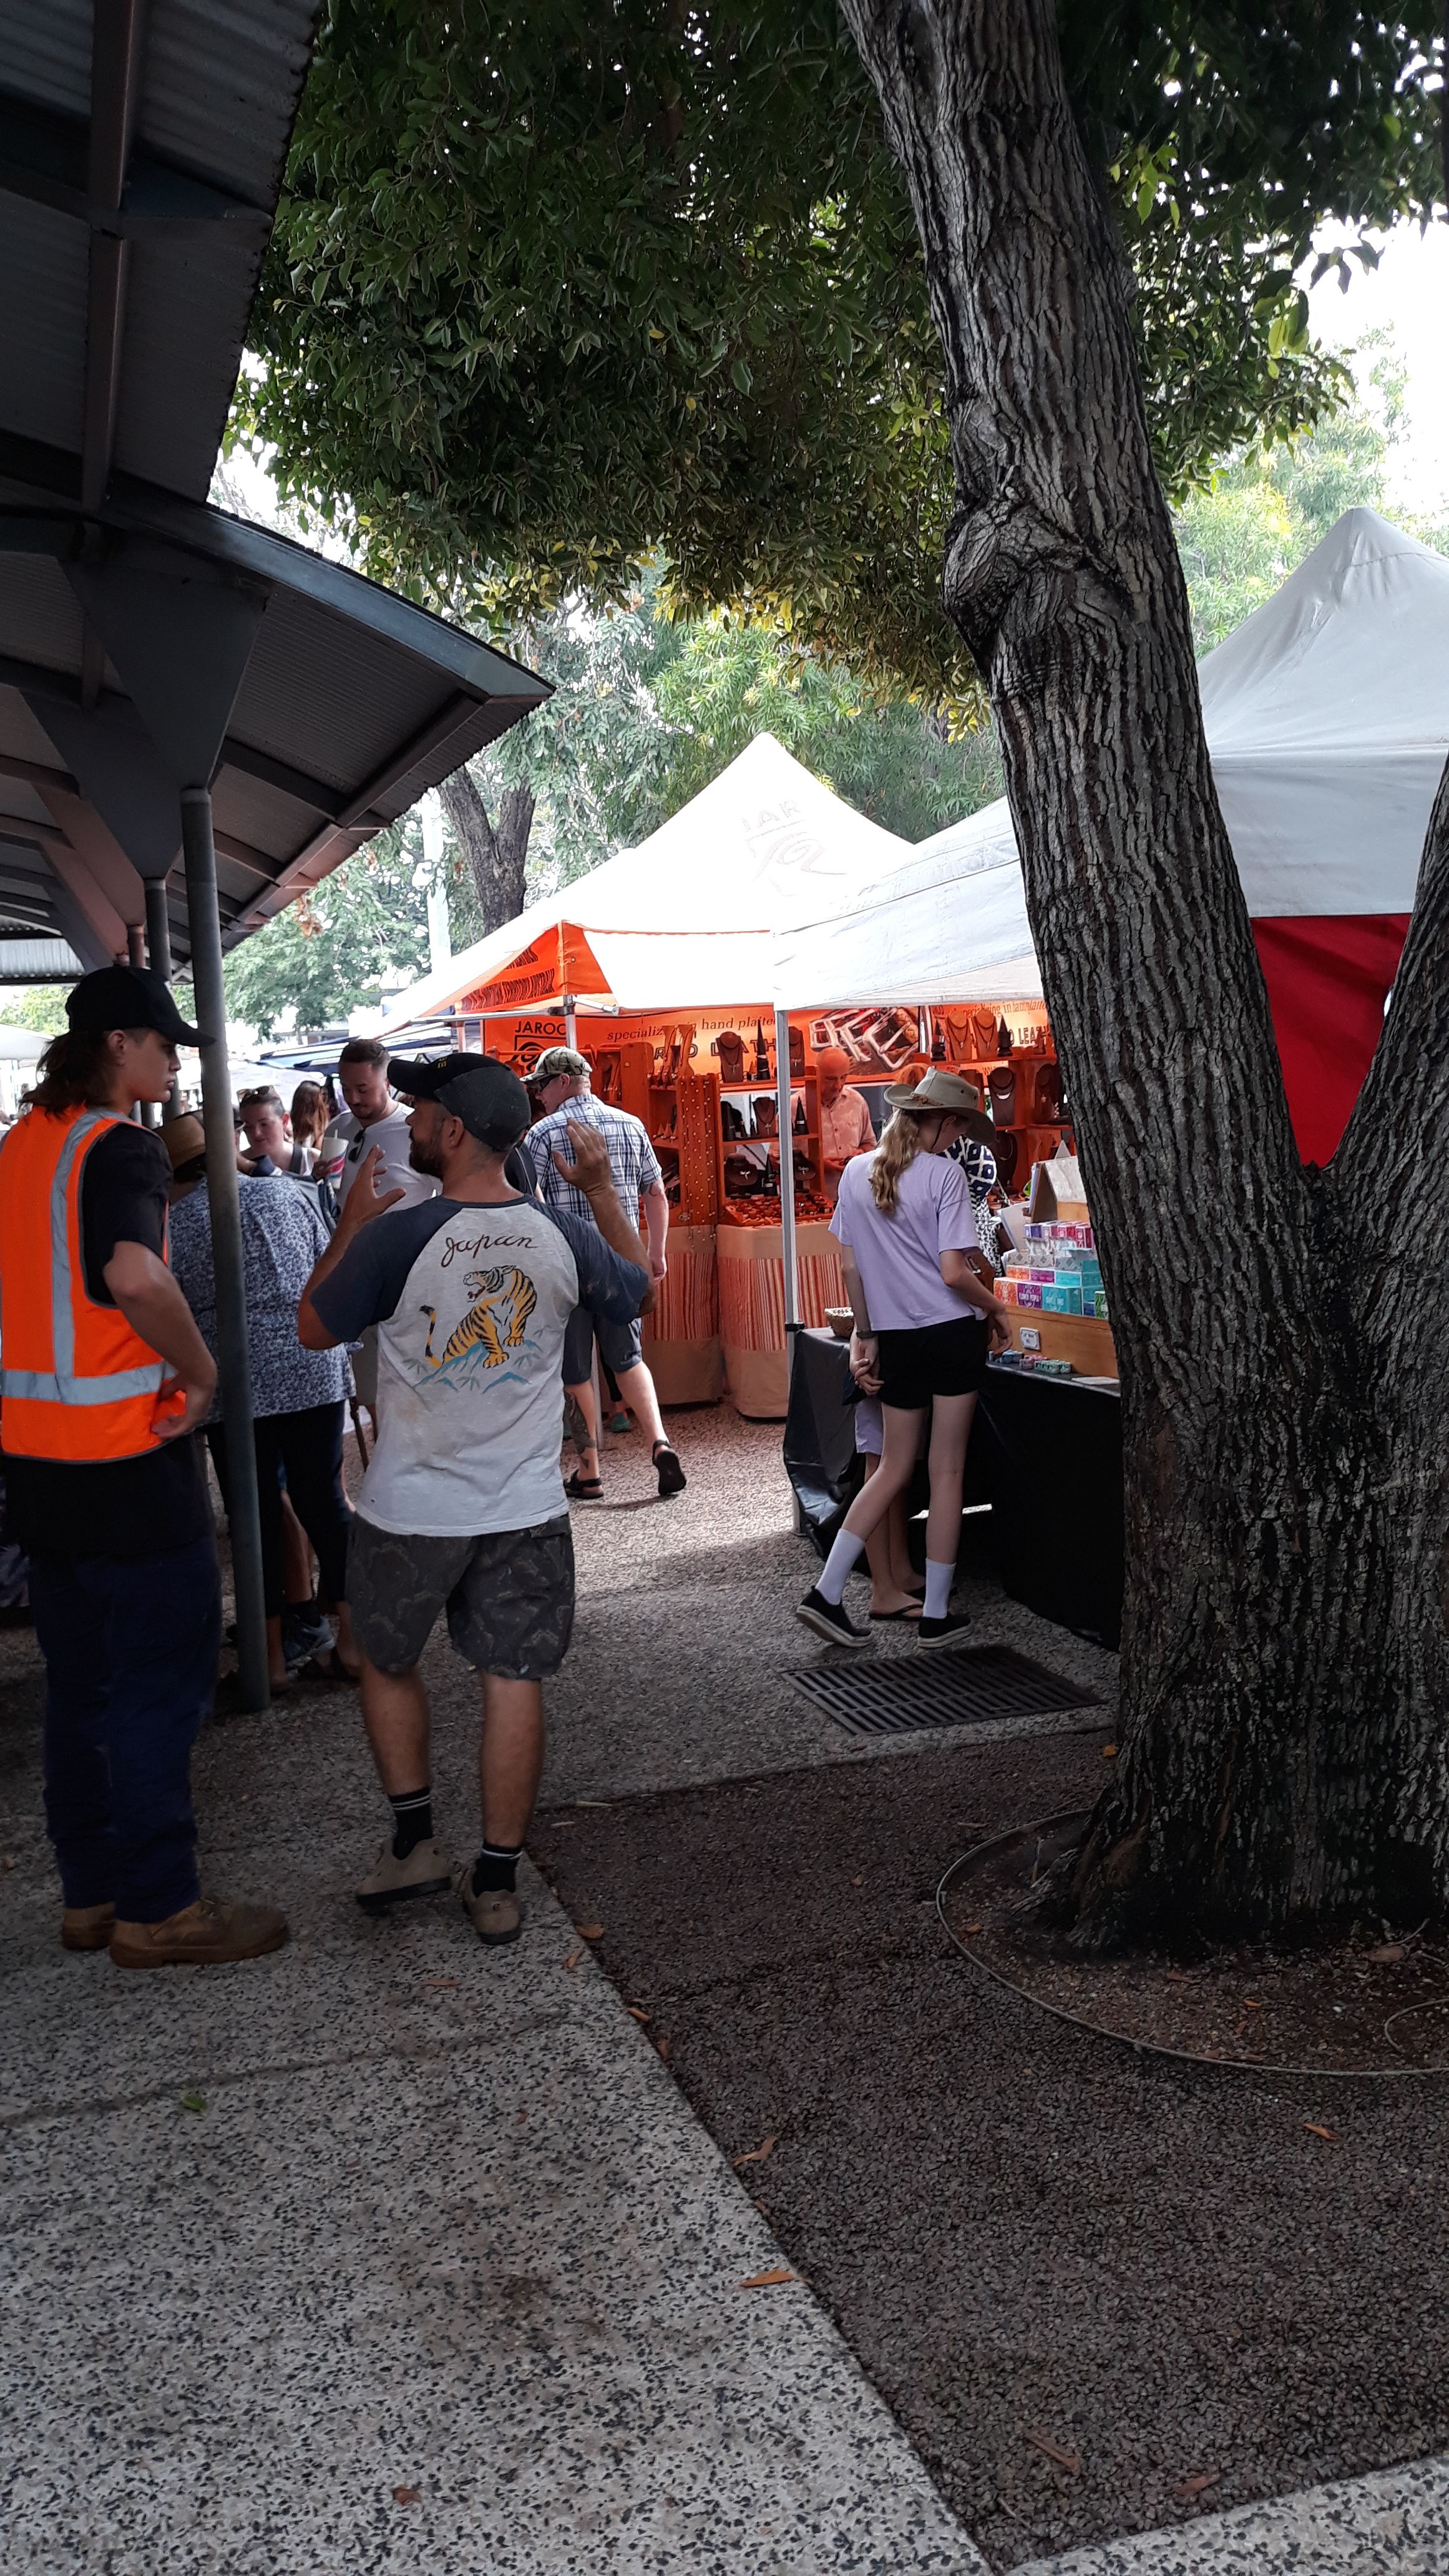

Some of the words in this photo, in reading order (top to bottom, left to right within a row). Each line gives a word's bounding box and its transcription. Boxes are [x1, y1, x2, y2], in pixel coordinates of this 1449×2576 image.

[607, 1026, 663, 1041] specializ
[701, 1017, 734, 1030] hand
[738, 1016, 775, 1031] plaite
[441, 1234, 539, 1267] Japan
